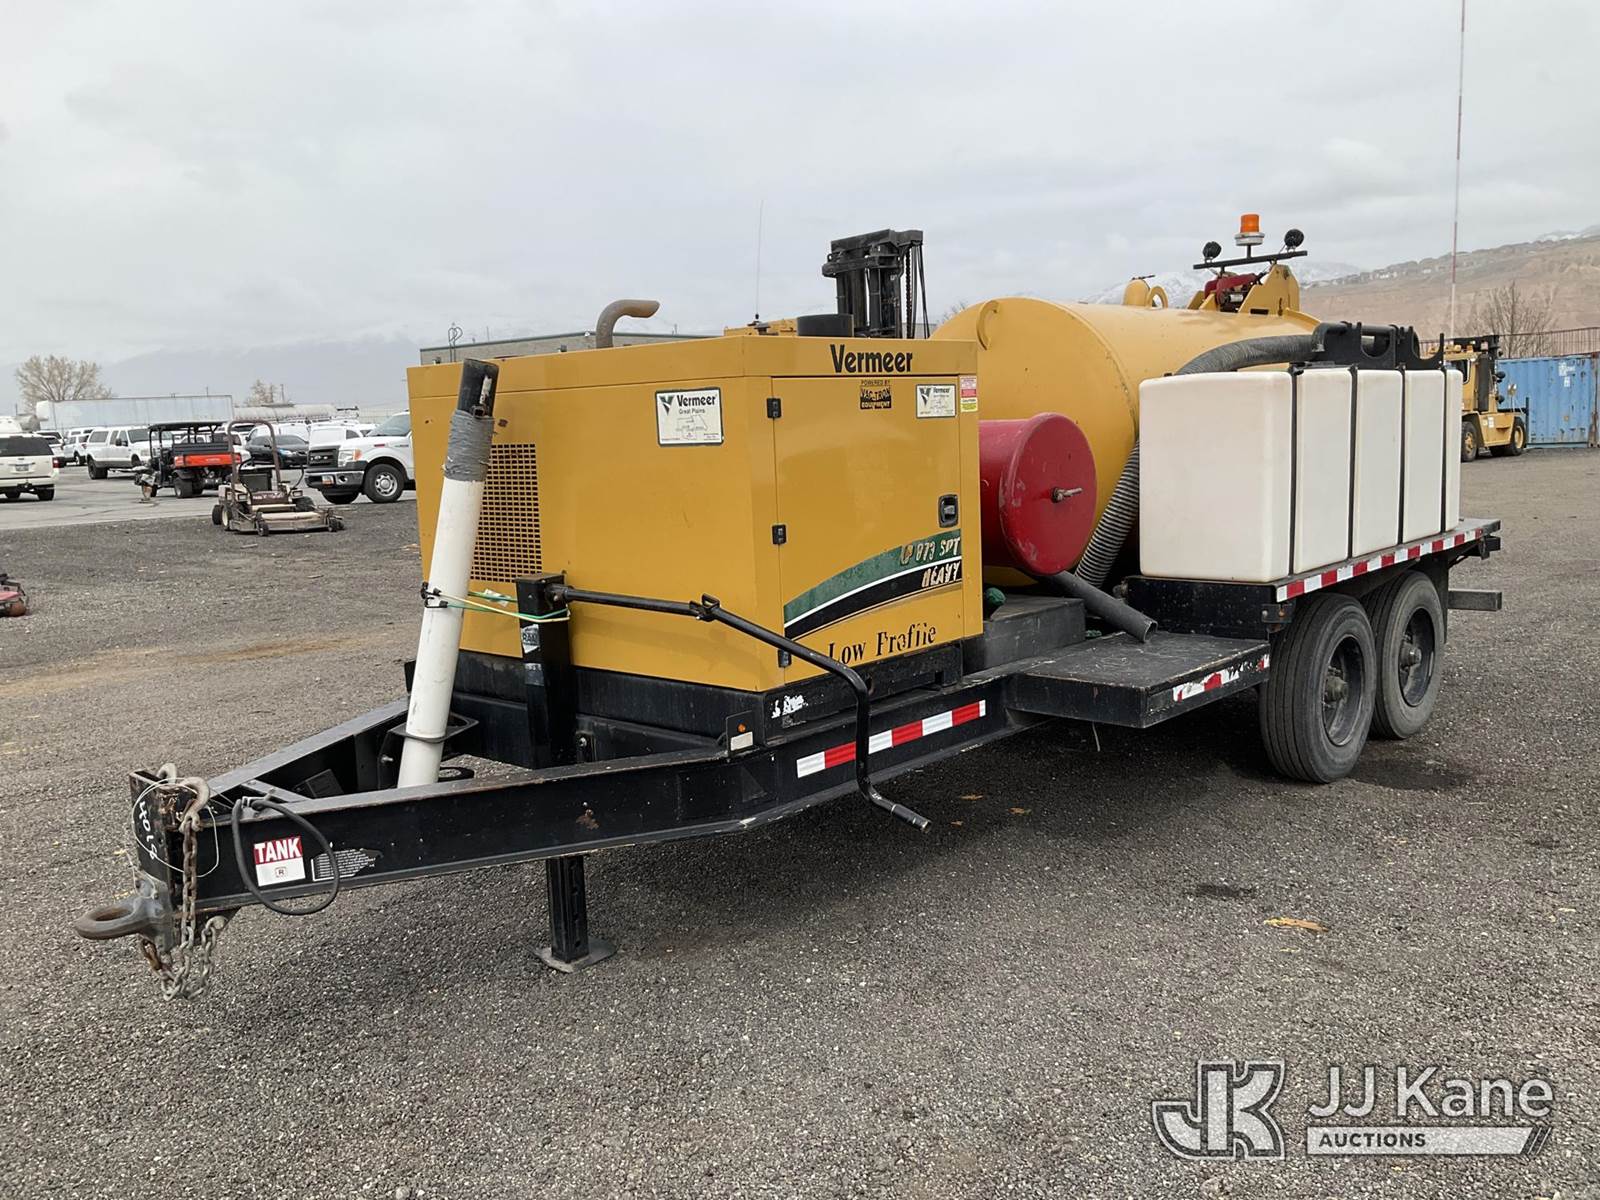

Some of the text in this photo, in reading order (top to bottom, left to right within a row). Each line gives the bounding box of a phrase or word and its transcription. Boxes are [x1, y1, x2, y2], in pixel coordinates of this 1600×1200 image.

[829, 344, 913, 373] Vermeer
[676, 394, 716, 407] Vermeer
[939, 536, 961, 557] SPT
[828, 641, 867, 665] Low
[254, 837, 302, 864] TANK
